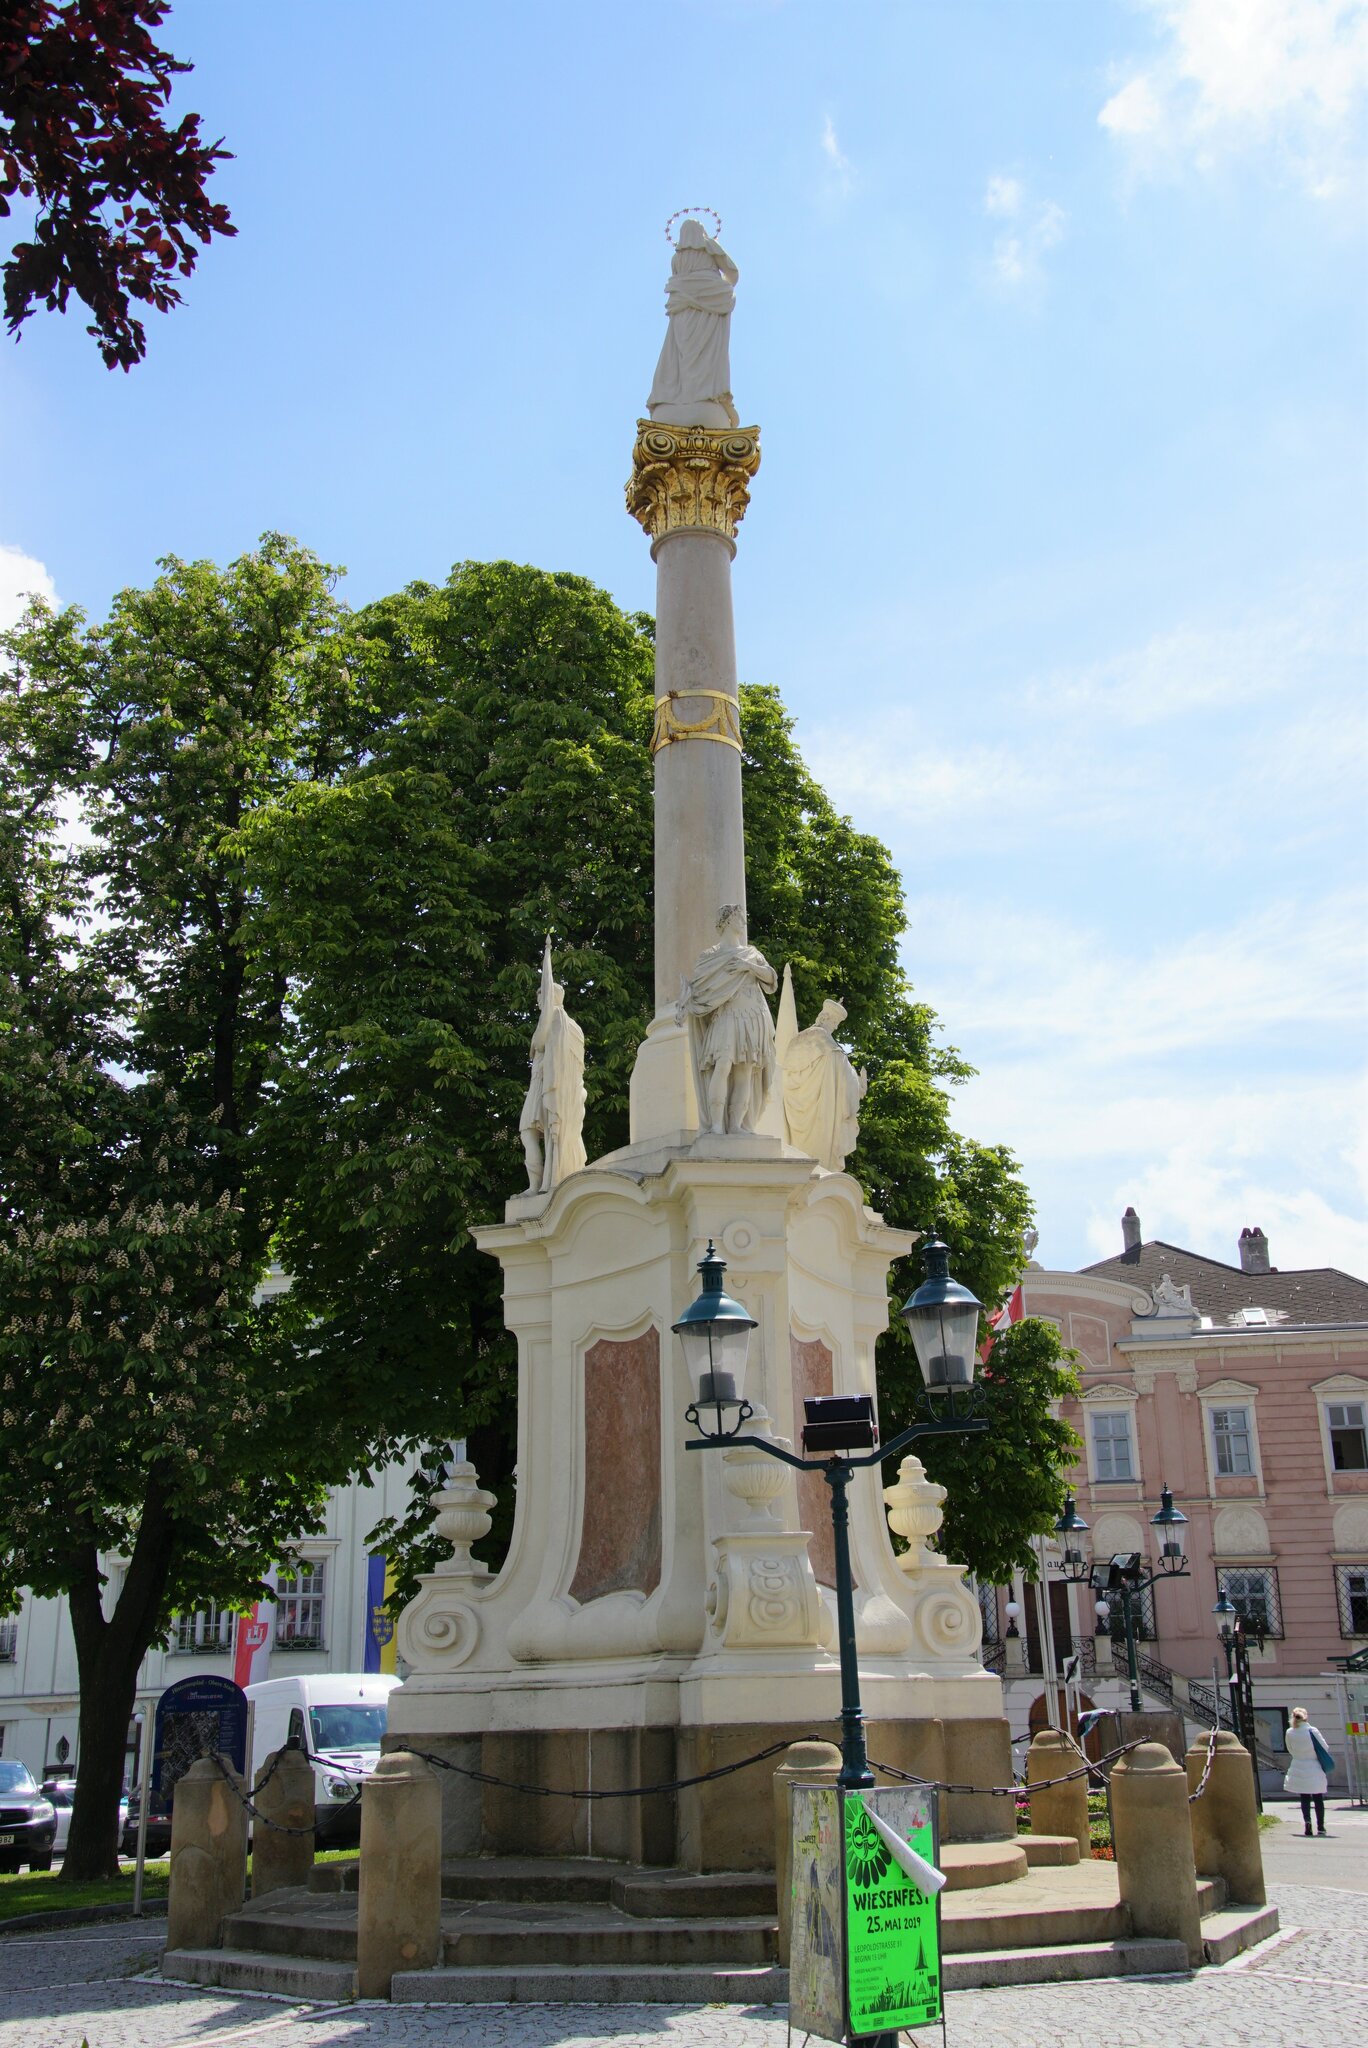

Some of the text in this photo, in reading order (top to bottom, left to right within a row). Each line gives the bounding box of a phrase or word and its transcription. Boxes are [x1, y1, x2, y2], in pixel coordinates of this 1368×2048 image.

[866, 1916, 921, 1934] 25. MAI 2019
[854, 1941, 896, 1954] LEOPOLDSTRASSE
[854, 1954, 871, 1964] BEGINN
